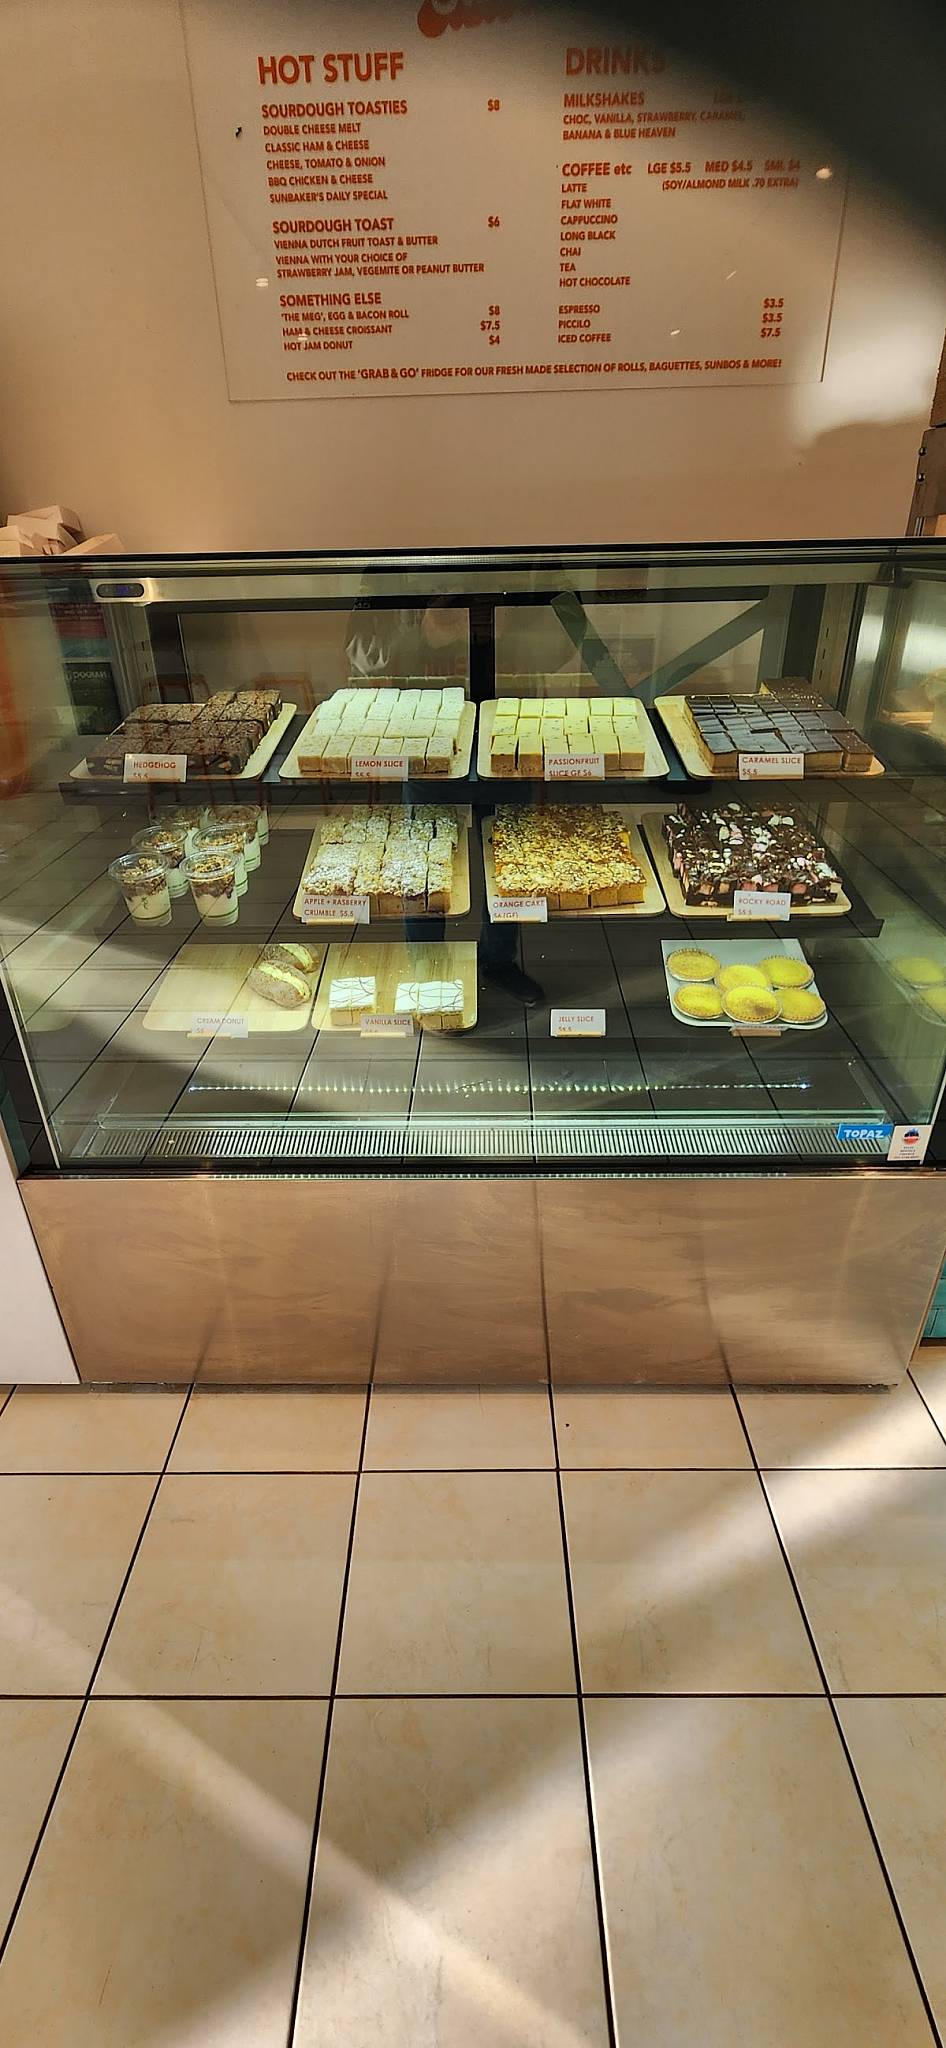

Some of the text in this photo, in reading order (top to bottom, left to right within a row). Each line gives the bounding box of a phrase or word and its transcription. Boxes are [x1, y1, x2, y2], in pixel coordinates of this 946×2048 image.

[565, 47, 666, 76] DRINKS
[257, 52, 404, 84] HOT STUFF
[488, 99, 500, 111] $8
[564, 91, 645, 108] MILKSHAKES
[261, 100, 408, 118] SOURDOUGH TOASTIES
[564, 114, 591, 125] CHOC,
[594, 113, 634, 124] VANILLA,
[263, 123, 361, 136] DOUBLE CHEESE MELT
[563, 127, 676, 141] BANANA & BLUE HEAVEN
[265, 140, 369, 153] CLASSIC HAM & CHEESE
[266, 156, 385, 170] CHEESE, TOMATO & ONION
[562, 162, 610, 177] COFFEE
[614, 164, 632, 175] etc
[648, 163, 667, 174] LGE
[670, 162, 691, 174] $5.5
[705, 161, 728, 172] MED
[731, 160, 752, 172] $4.5
[268, 174, 373, 187] BBQ CHICKEN & CHEESE
[662, 179, 726, 191] (SOY/ALMOND
[728, 178, 750, 189] MILK
[561, 183, 587, 193] LATTE
[270, 190, 388, 204] SUNBAKER'S DAILY SPECIAL
[561, 199, 611, 209] FLAT WHITE
[272, 218, 394, 234] SOURDOUGH TOAST
[487, 216, 500, 228] $6
[561, 215, 618, 225] CAPPUCCINO
[560, 230, 616, 241] LONG BLACK
[274, 236, 438, 250] VIENNA DUTCH FRUIT TOAST & BUTTER
[560, 247, 582, 256] CHAI
[275, 252, 408, 265] VIENNA WITH YOUR CHOICE OF
[277, 263, 485, 278] STRAWBERRY JAM, VEGEMITE OR PEANUT BUTTER
[560, 263, 576, 272] TEA
[559, 276, 630, 287] HOT CHOCOLATE
[279, 292, 382, 308] SOMETHING ELSE
[764, 298, 784, 309] $3.5
[489, 305, 500, 316] $8
[559, 304, 600, 314] ESPRESSO
[281, 313, 300, 322] 'THE
[327, 311, 346, 320] EGG
[348, 311, 354, 320] &
[356, 310, 387, 319] BACON
[388, 309, 409, 319] ROLL
[762, 313, 782, 323] $3.5
[282, 325, 393, 337] HAM & CHEESE CROISSANT
[480, 320, 500, 331] $7.5
[558, 333, 611, 343] ICED COFFEE
[760, 327, 781, 338] $7.5
[284, 341, 353, 351] HOT JAM DONUT
[489, 335, 500, 346] $4
[287, 358, 781, 381] CHECK OUT THE 'GRAB & GO' FRIDGE FOR OUR FRESH MADE SELECTION OF ROLLS, BAGUETTES, SUNBOS & MORE!
[844, 1129, 884, 1138] TOPAZ
